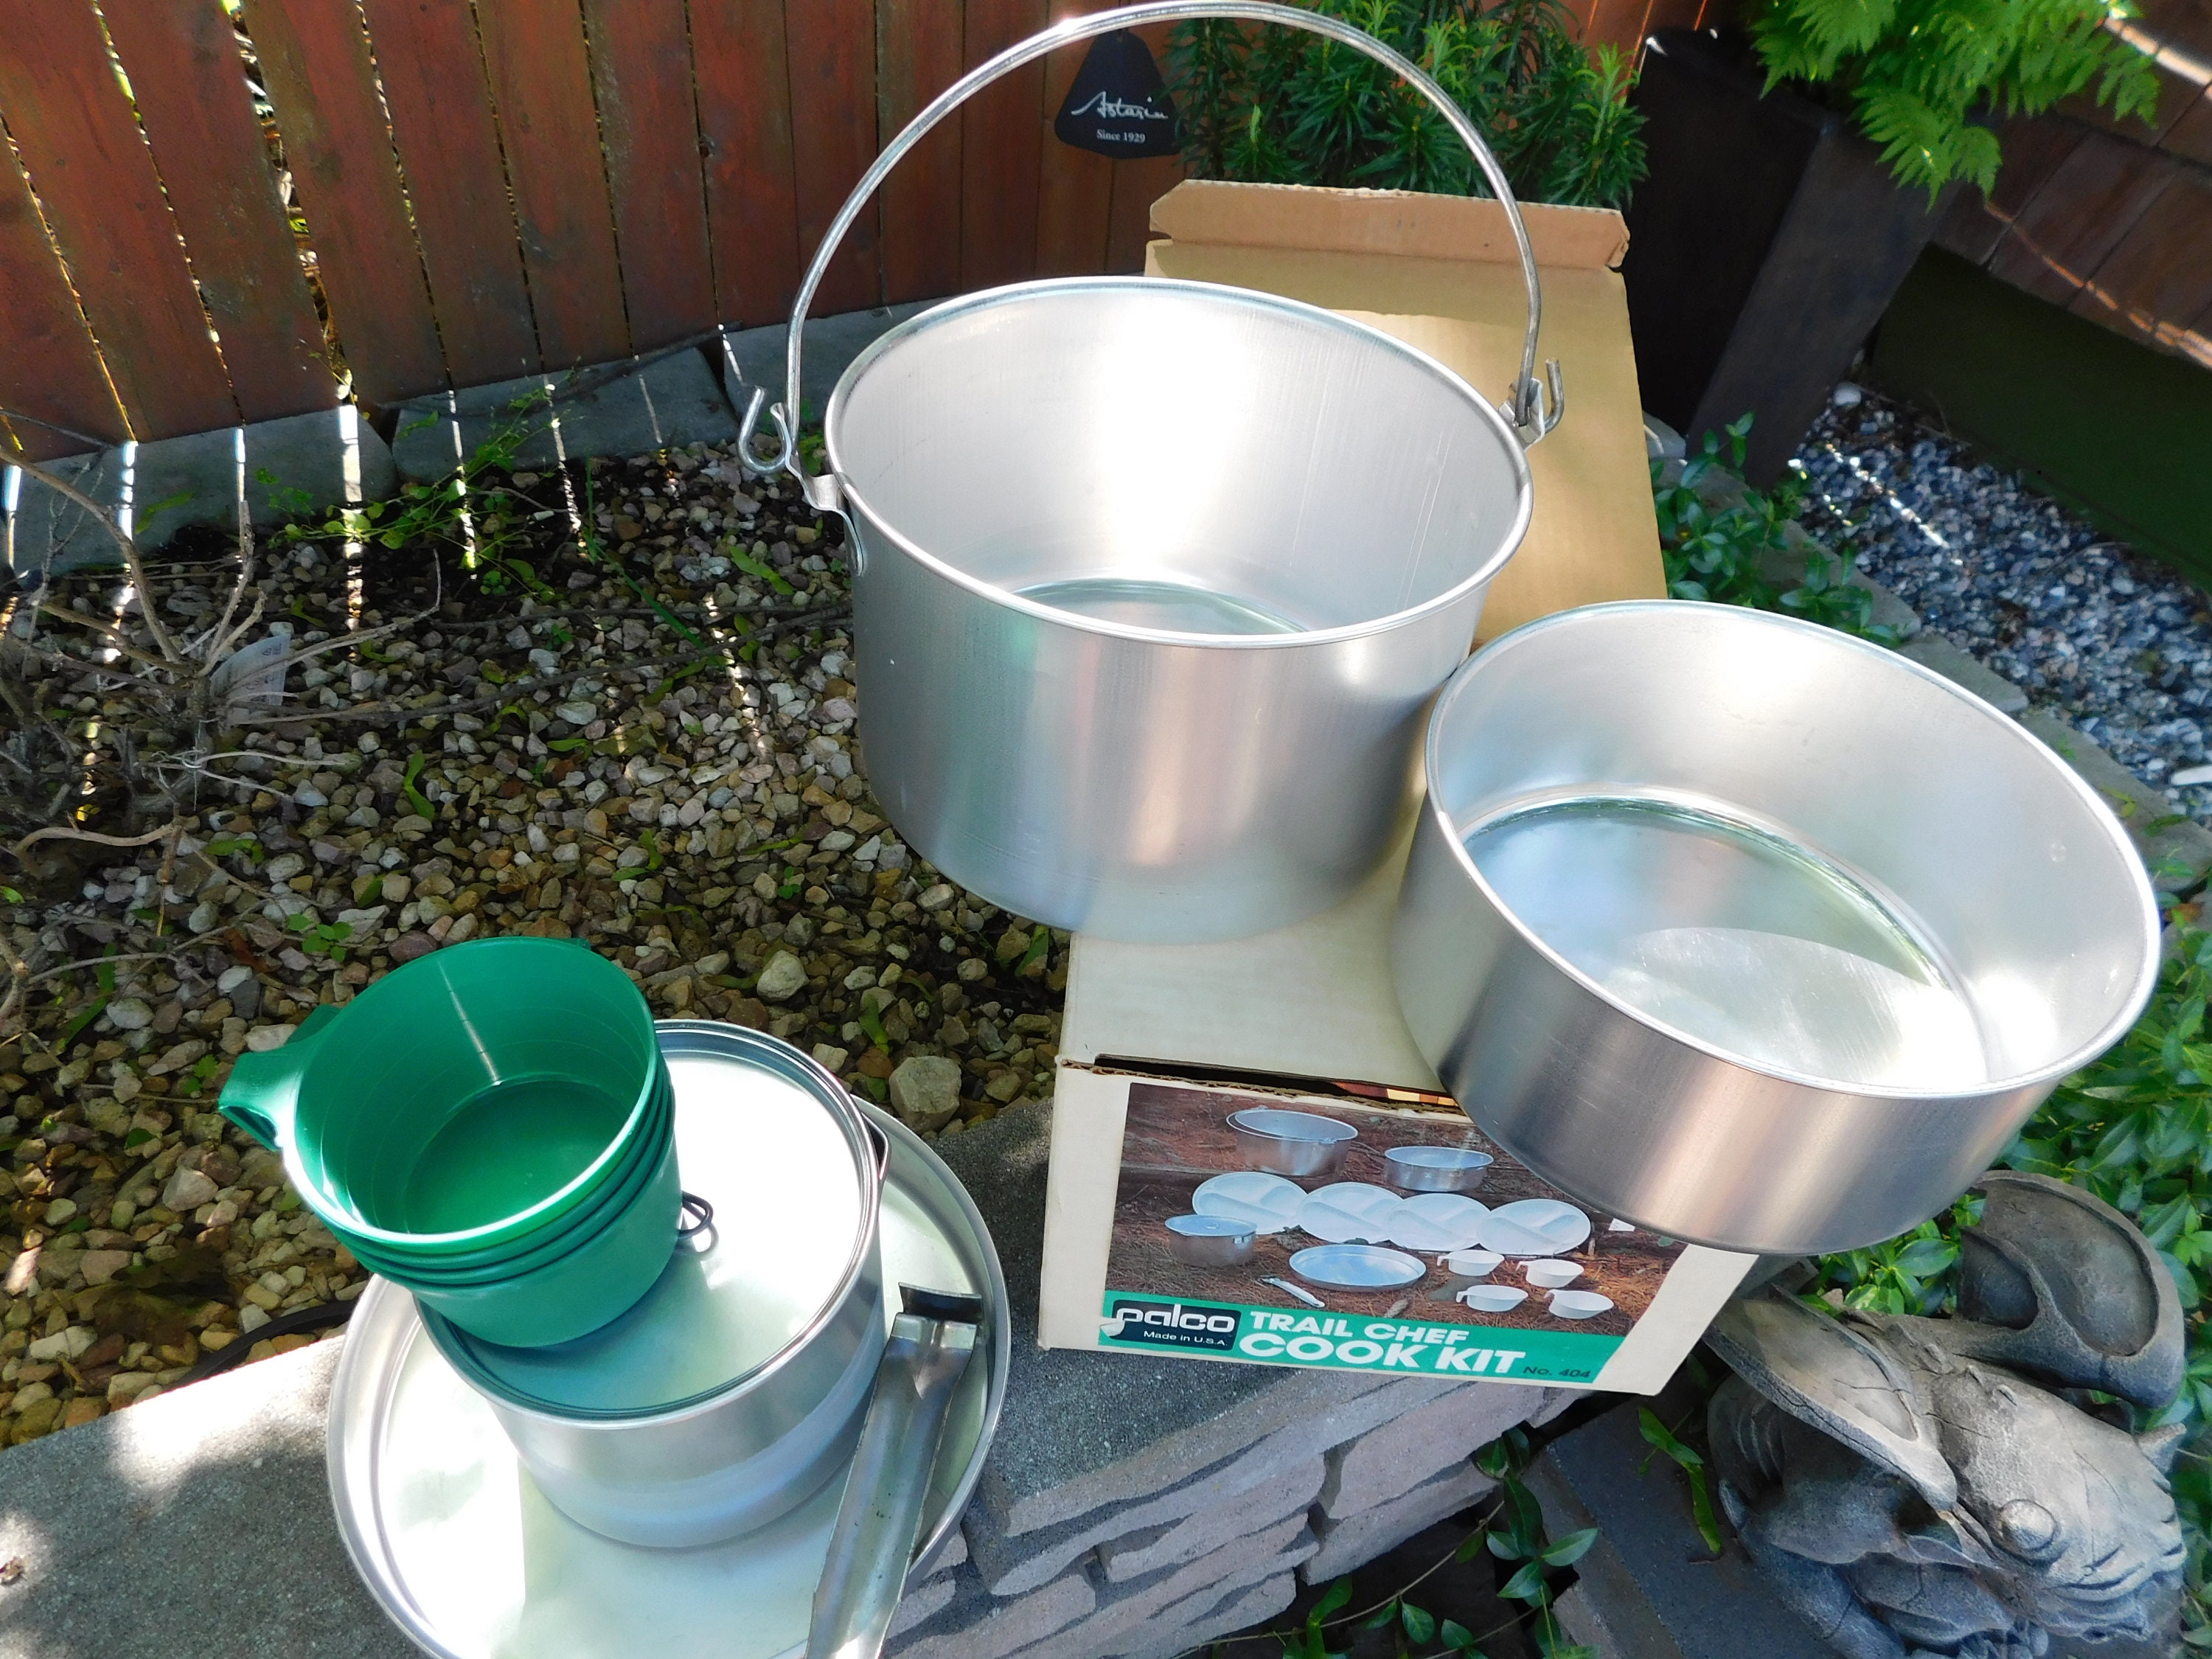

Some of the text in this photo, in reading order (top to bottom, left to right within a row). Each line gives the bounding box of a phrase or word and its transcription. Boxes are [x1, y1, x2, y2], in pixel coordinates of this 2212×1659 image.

[1096, 128, 1146, 143] Since 1929
[1116, 1304, 1235, 1333] palco
[1251, 1312, 1470, 1345] TRAIL CHEF
[1144, 1330, 1177, 1340] Made
[1194, 1336, 1228, 1346] U.S.A.
[1239, 1332, 1526, 1374] COOK KIT
[1523, 1366, 1591, 1378] No. 404
